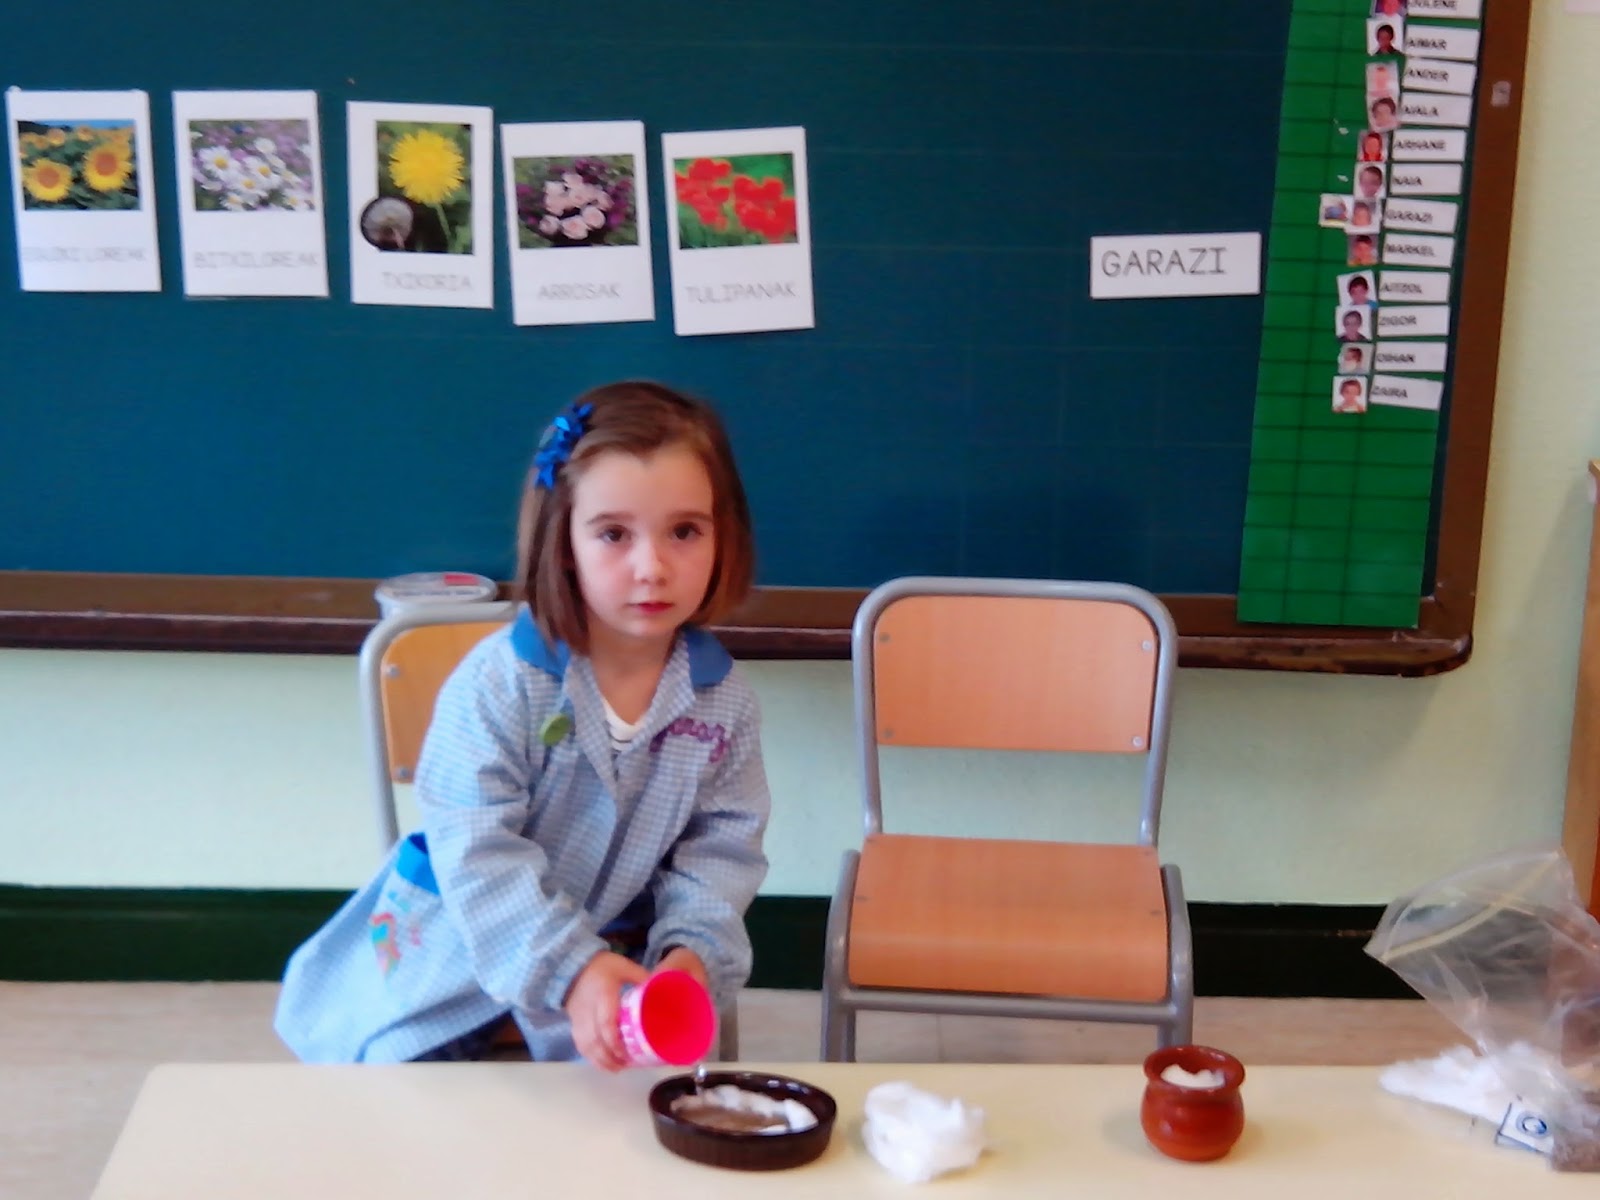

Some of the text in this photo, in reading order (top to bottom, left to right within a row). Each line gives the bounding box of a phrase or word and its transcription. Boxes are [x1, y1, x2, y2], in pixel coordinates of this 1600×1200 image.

[1101, 246, 1227, 278] GARAZI
[536, 282, 622, 301] ARROSAK
[684, 280, 798, 304] TULIPANAK
